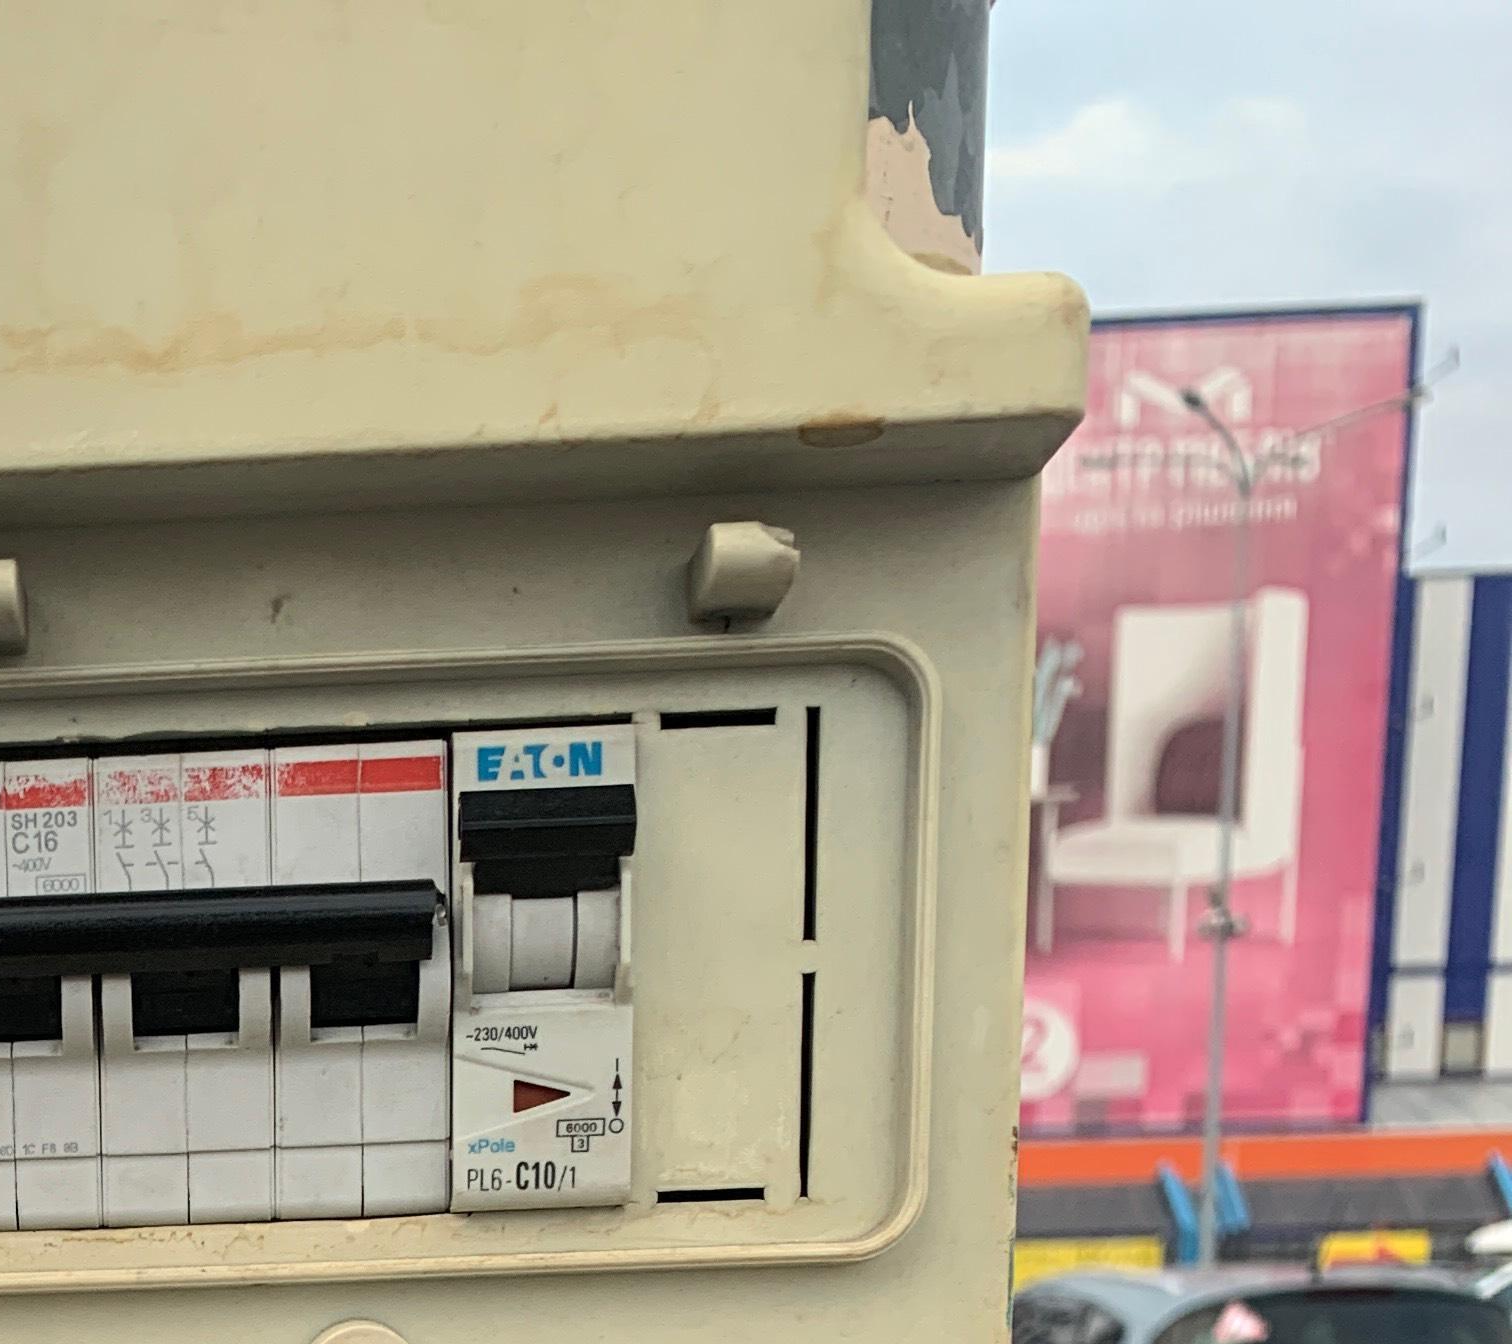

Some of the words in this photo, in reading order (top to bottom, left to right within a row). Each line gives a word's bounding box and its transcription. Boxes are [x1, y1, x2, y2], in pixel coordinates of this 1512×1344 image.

[477, 741, 603, 782] EATON
[11, 812, 37, 831] SH
[42, 810, 78, 829] 203
[140, 808, 153, 824] 3
[187, 805, 200, 821] 5
[42, 878, 80, 892] 6000
[566, 1121, 598, 1134] 6000
[467, 1138, 516, 1155] xPole
[577, 1138, 585, 1149] 3
[466, 1160, 577, 1192] PL6-C10/1
